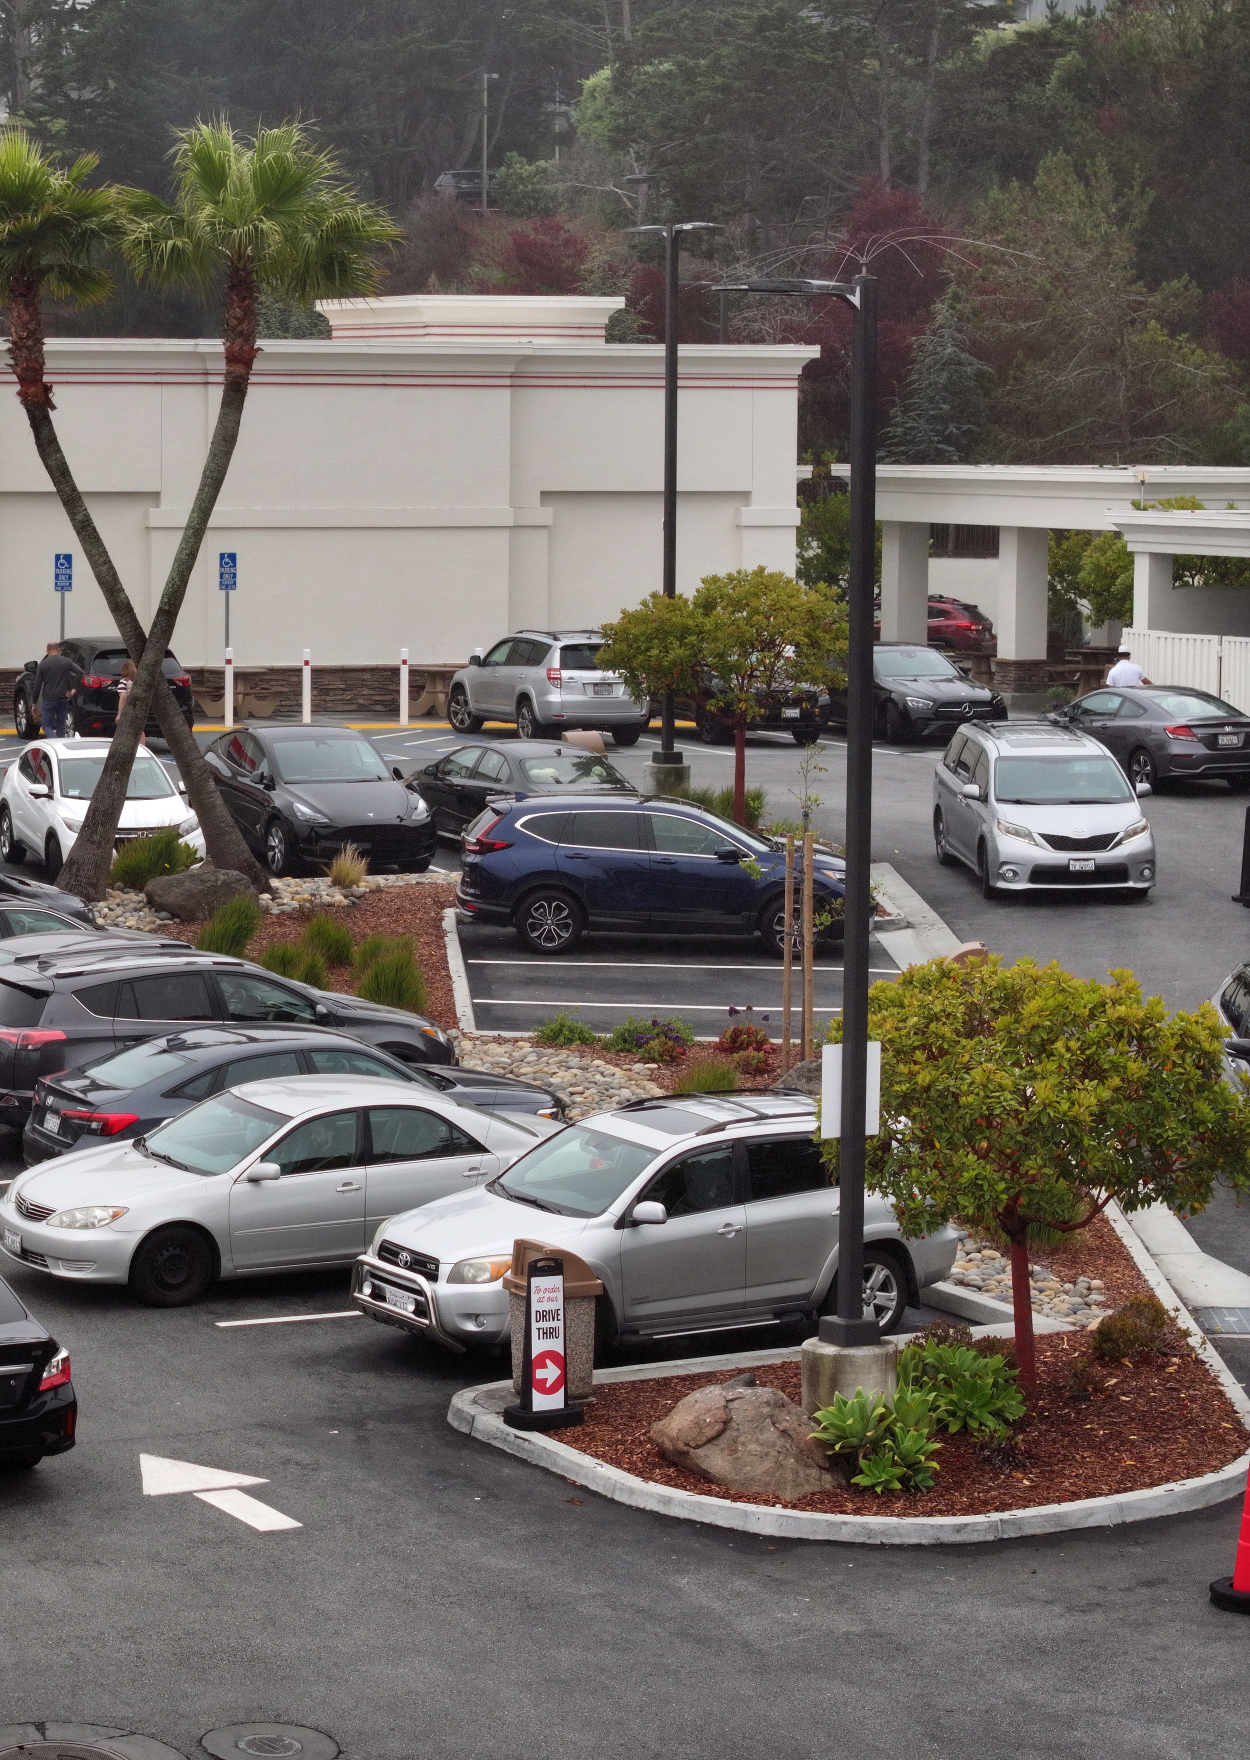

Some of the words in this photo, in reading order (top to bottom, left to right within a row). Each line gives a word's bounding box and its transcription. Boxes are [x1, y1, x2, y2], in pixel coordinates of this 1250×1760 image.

[533, 1285, 542, 1295] To
[542, 1284, 561, 1294] order
[536, 1295, 545, 1304] at
[546, 1295, 559, 1303] our
[535, 1308, 561, 1323] DRIVE
[536, 1326, 560, 1340] THRU
